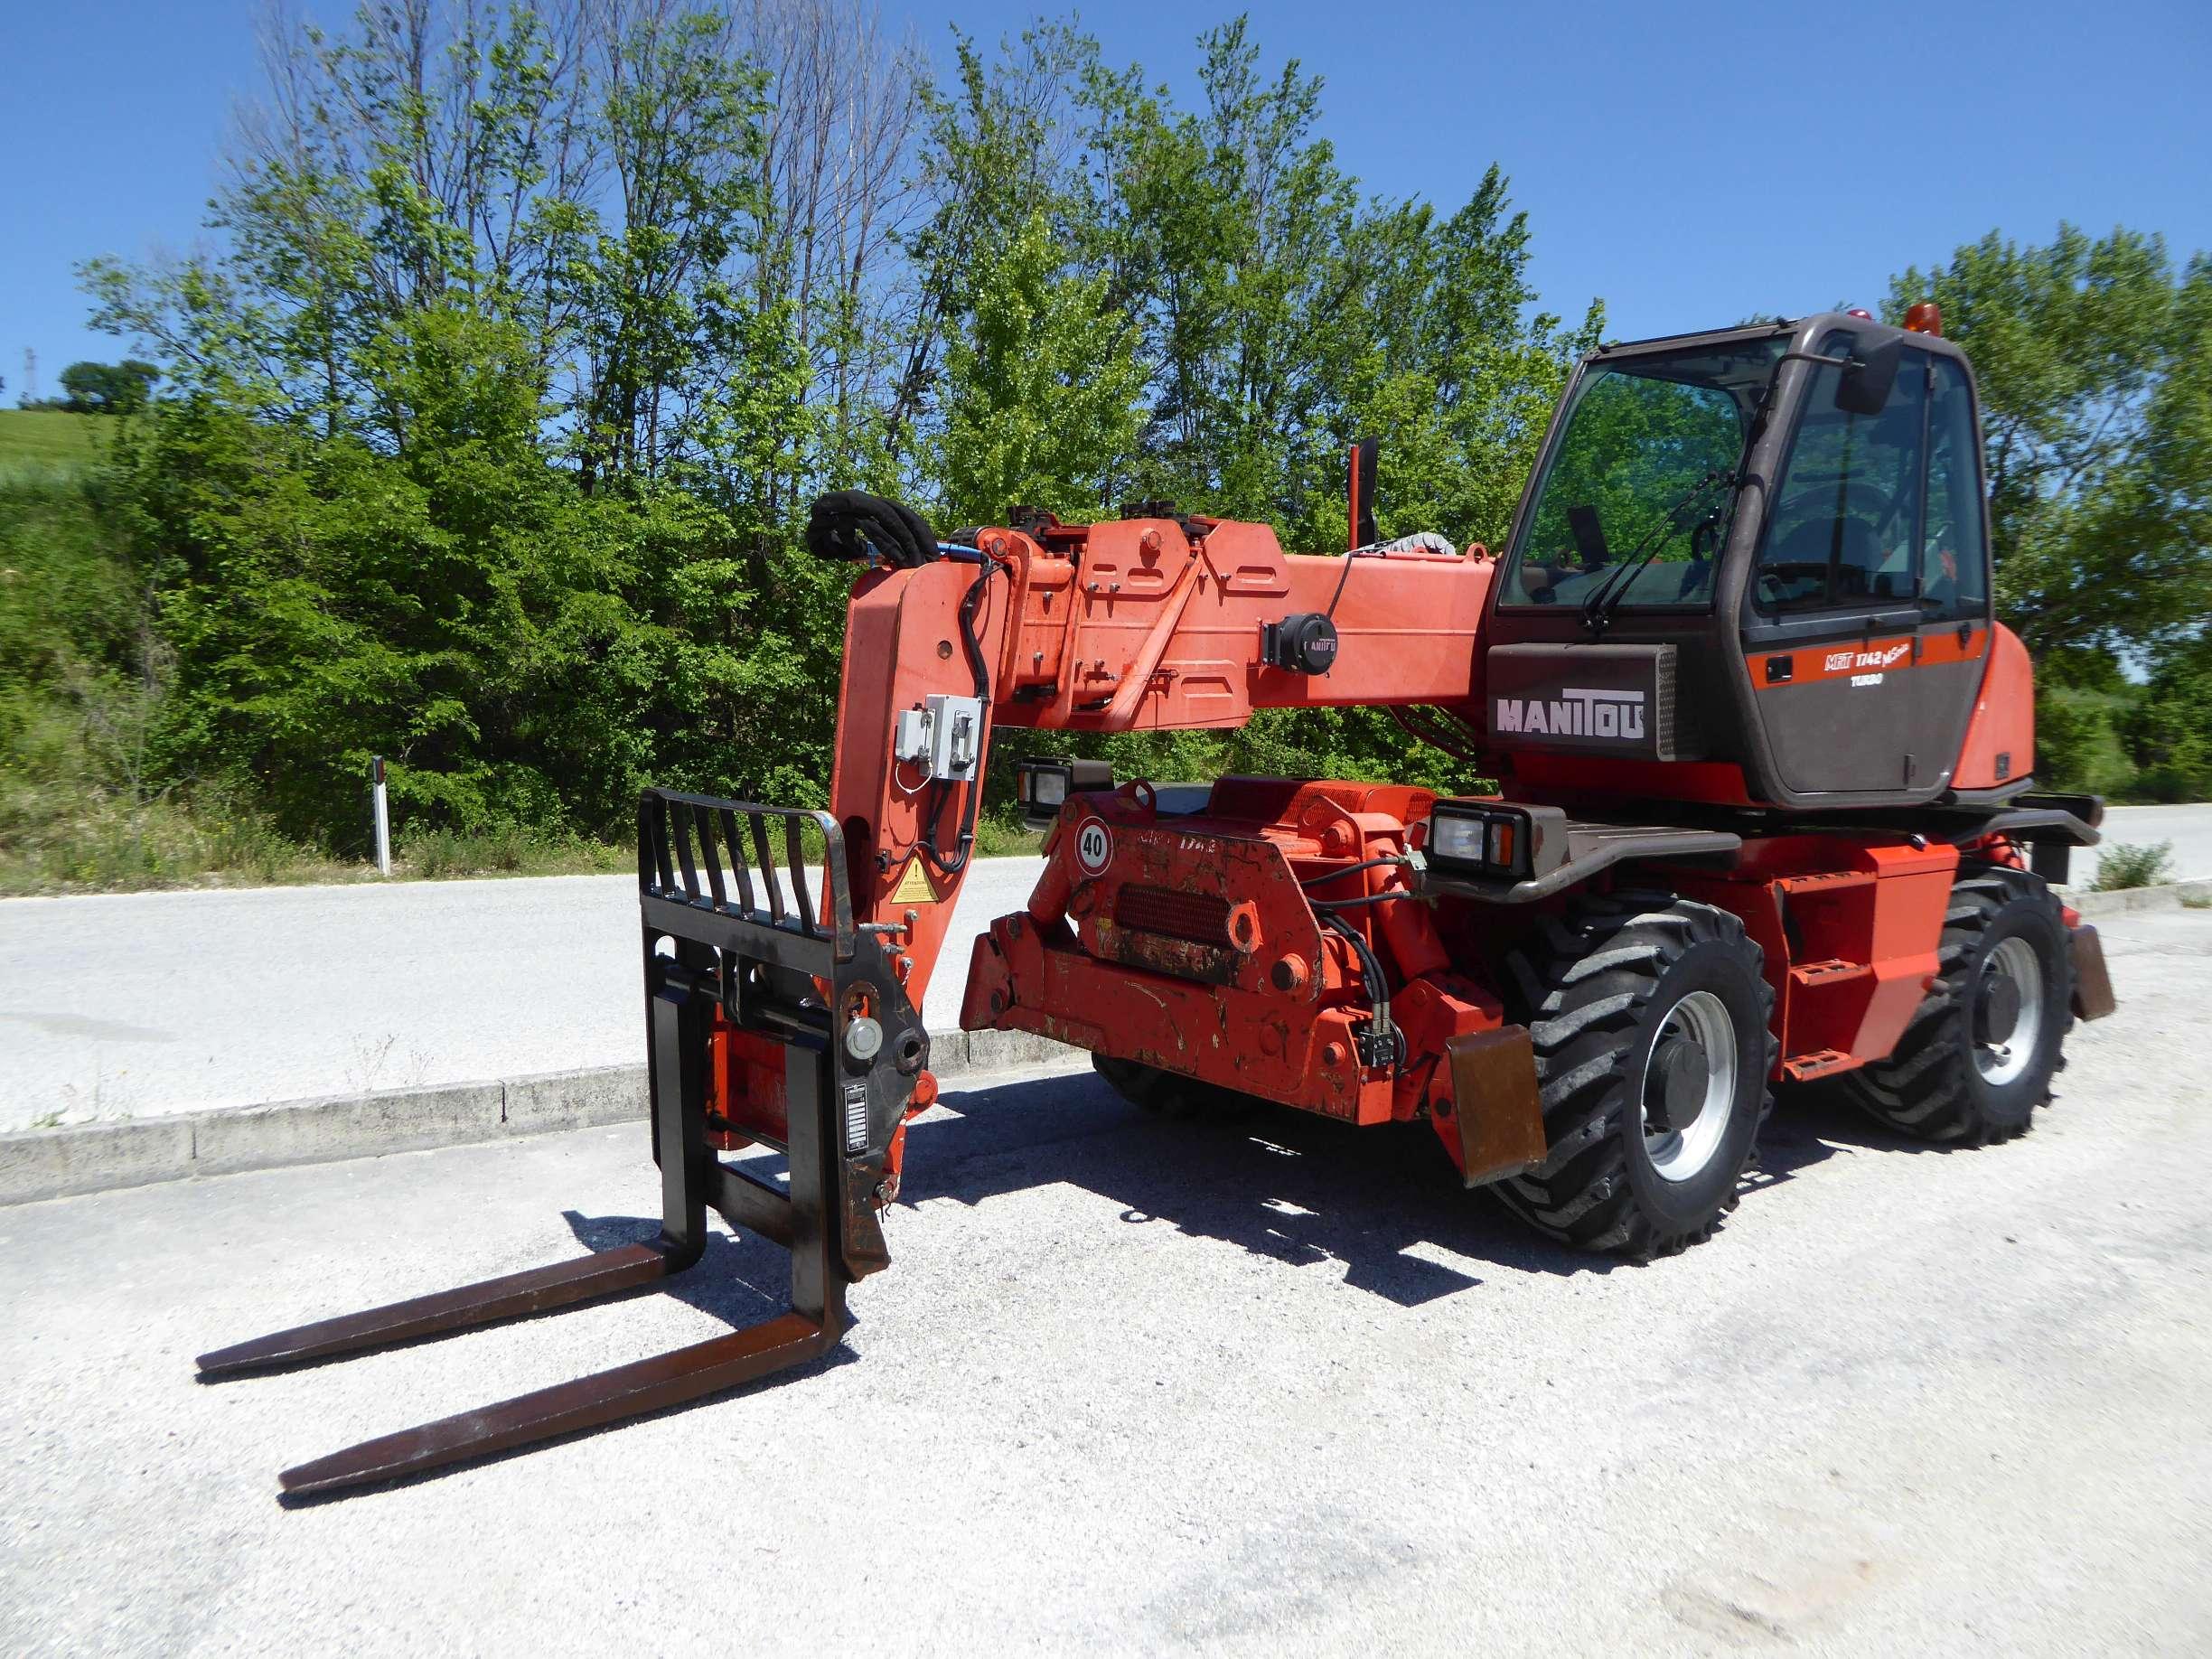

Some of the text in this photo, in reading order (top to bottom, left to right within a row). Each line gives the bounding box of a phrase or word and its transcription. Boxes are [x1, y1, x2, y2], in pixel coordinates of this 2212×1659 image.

[1823, 651, 1854, 671] MRT
[1855, 651, 1882, 667] 1742
[1496, 688, 1645, 739] MANITOU
[1083, 832, 1103, 858] 40
